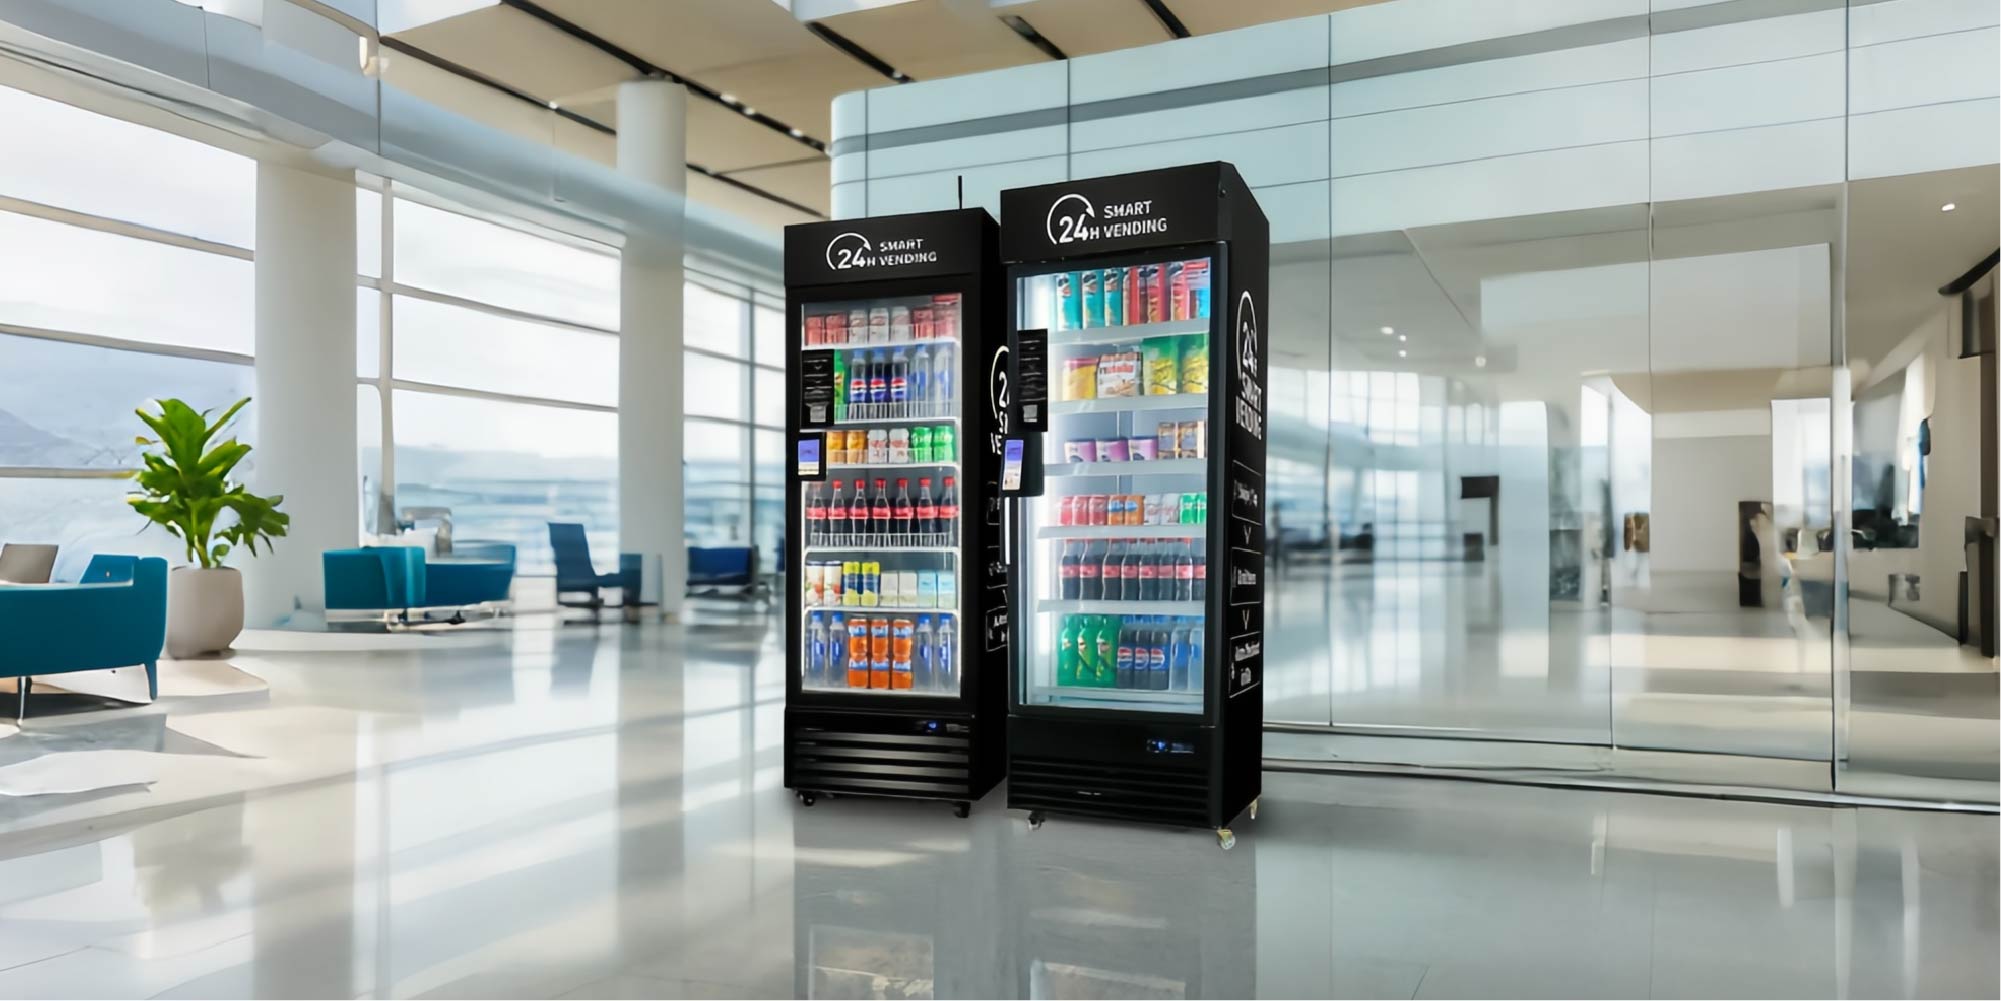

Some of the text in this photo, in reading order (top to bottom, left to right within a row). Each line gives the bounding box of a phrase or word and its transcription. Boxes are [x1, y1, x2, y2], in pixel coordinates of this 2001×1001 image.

[1103, 199, 1153, 219] SMART
[1103, 218, 1168, 239] VENDING
[879, 238, 925, 253] SMART
[879, 250, 938, 267] VENDING
